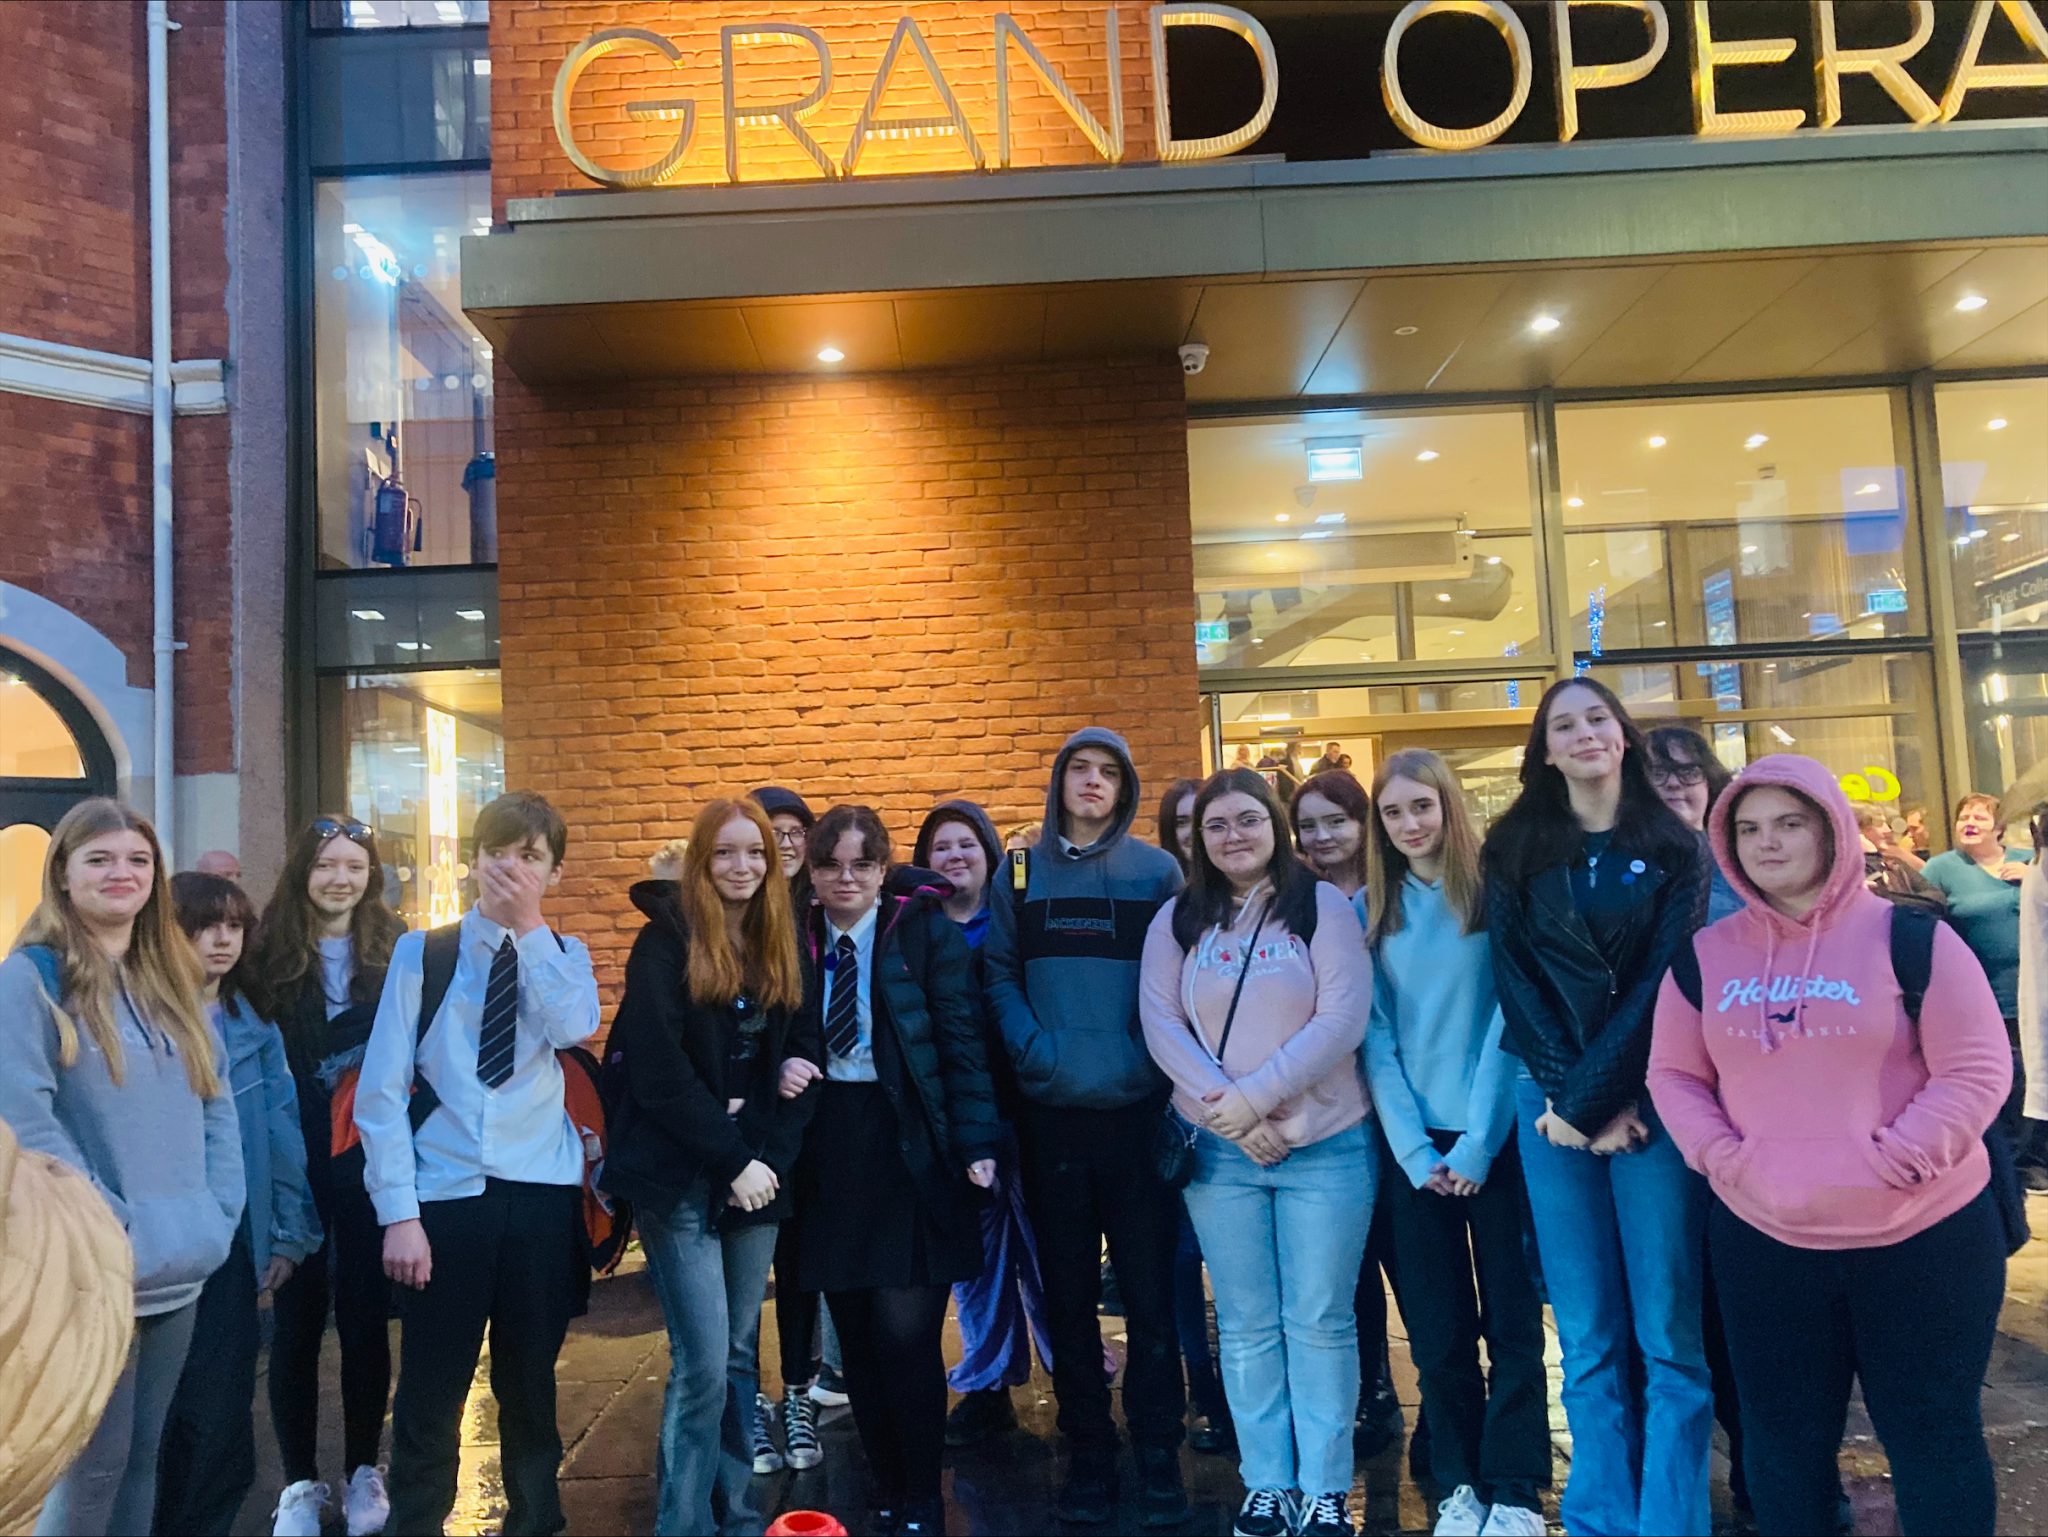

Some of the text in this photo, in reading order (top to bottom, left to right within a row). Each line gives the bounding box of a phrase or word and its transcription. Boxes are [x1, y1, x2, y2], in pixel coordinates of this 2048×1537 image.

[553, 0, 2048, 188] GRAND OPERA
[1717, 974, 1861, 1012] Hollister
[1726, 1026, 1857, 1040] CALFORNIA
